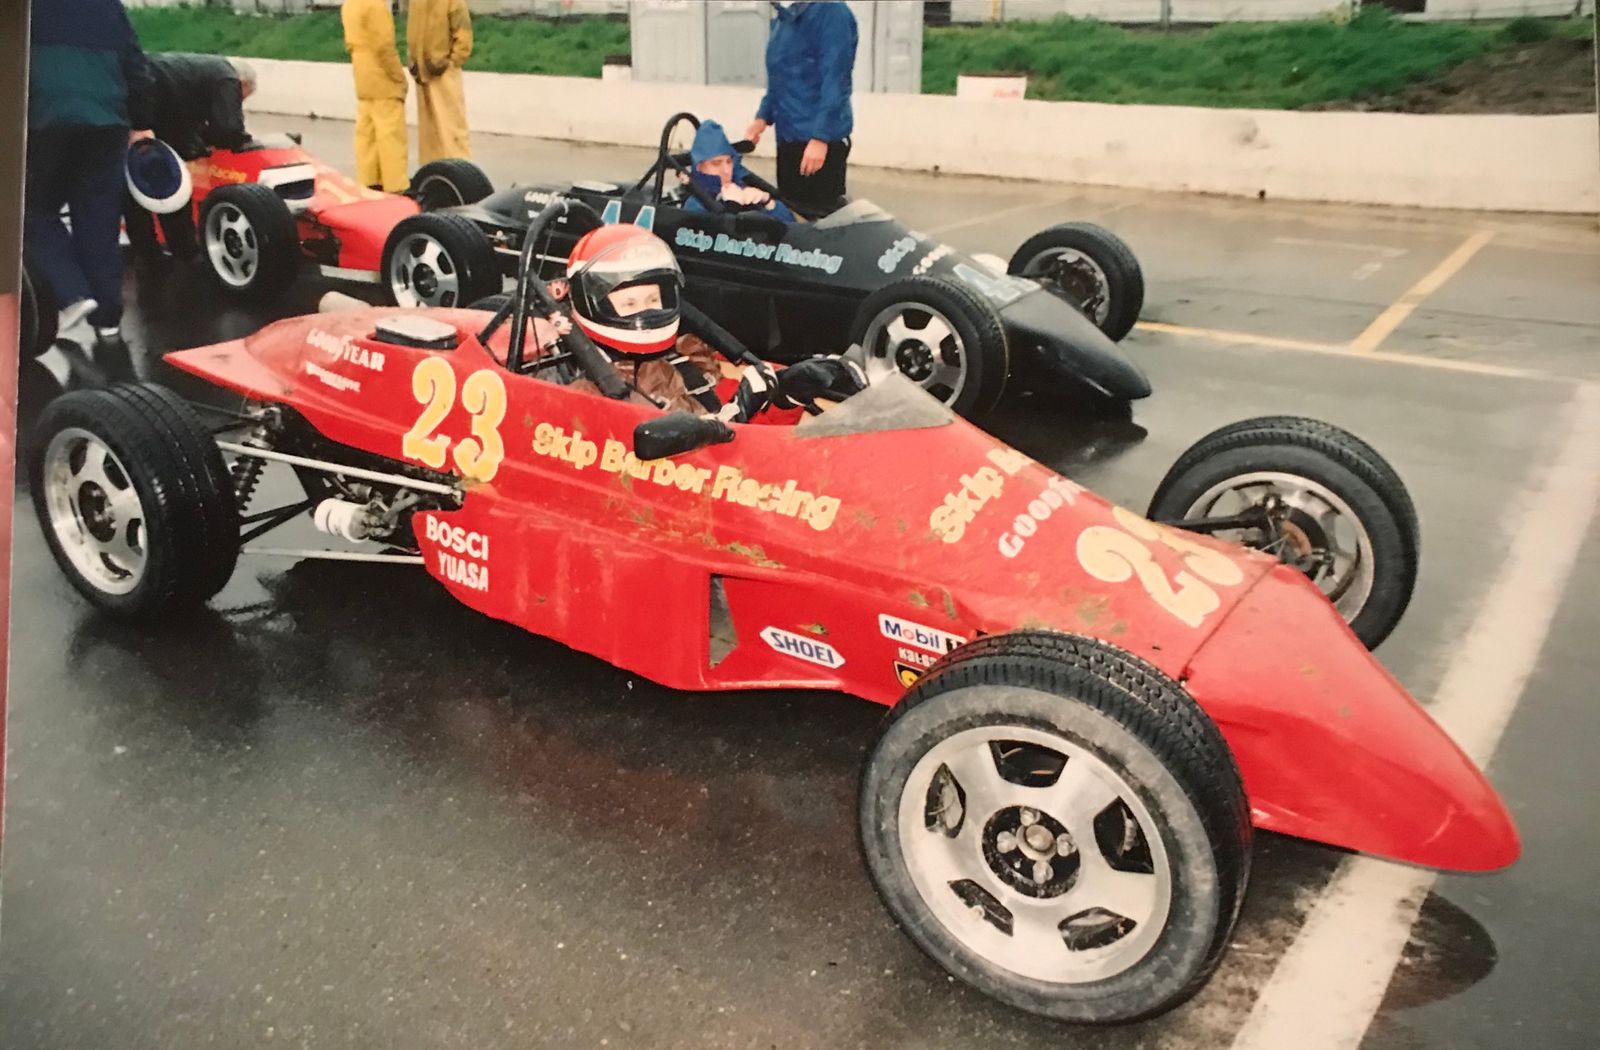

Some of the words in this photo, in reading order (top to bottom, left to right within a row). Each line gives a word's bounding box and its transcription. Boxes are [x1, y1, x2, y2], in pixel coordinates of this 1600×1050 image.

[675, 227, 713, 252] Skip
[775, 243, 844, 275] Racing
[402, 355, 508, 484] 23
[532, 422, 598, 470] Skip
[600, 438, 712, 494] Barber
[711, 464, 841, 531] Racing
[929, 466, 1004, 543] Skip
[426, 513, 489, 561] BOSCI
[438, 549, 489, 593] YUASA
[770, 631, 835, 665] SHOEI
[884, 619, 940, 649] Mobil
